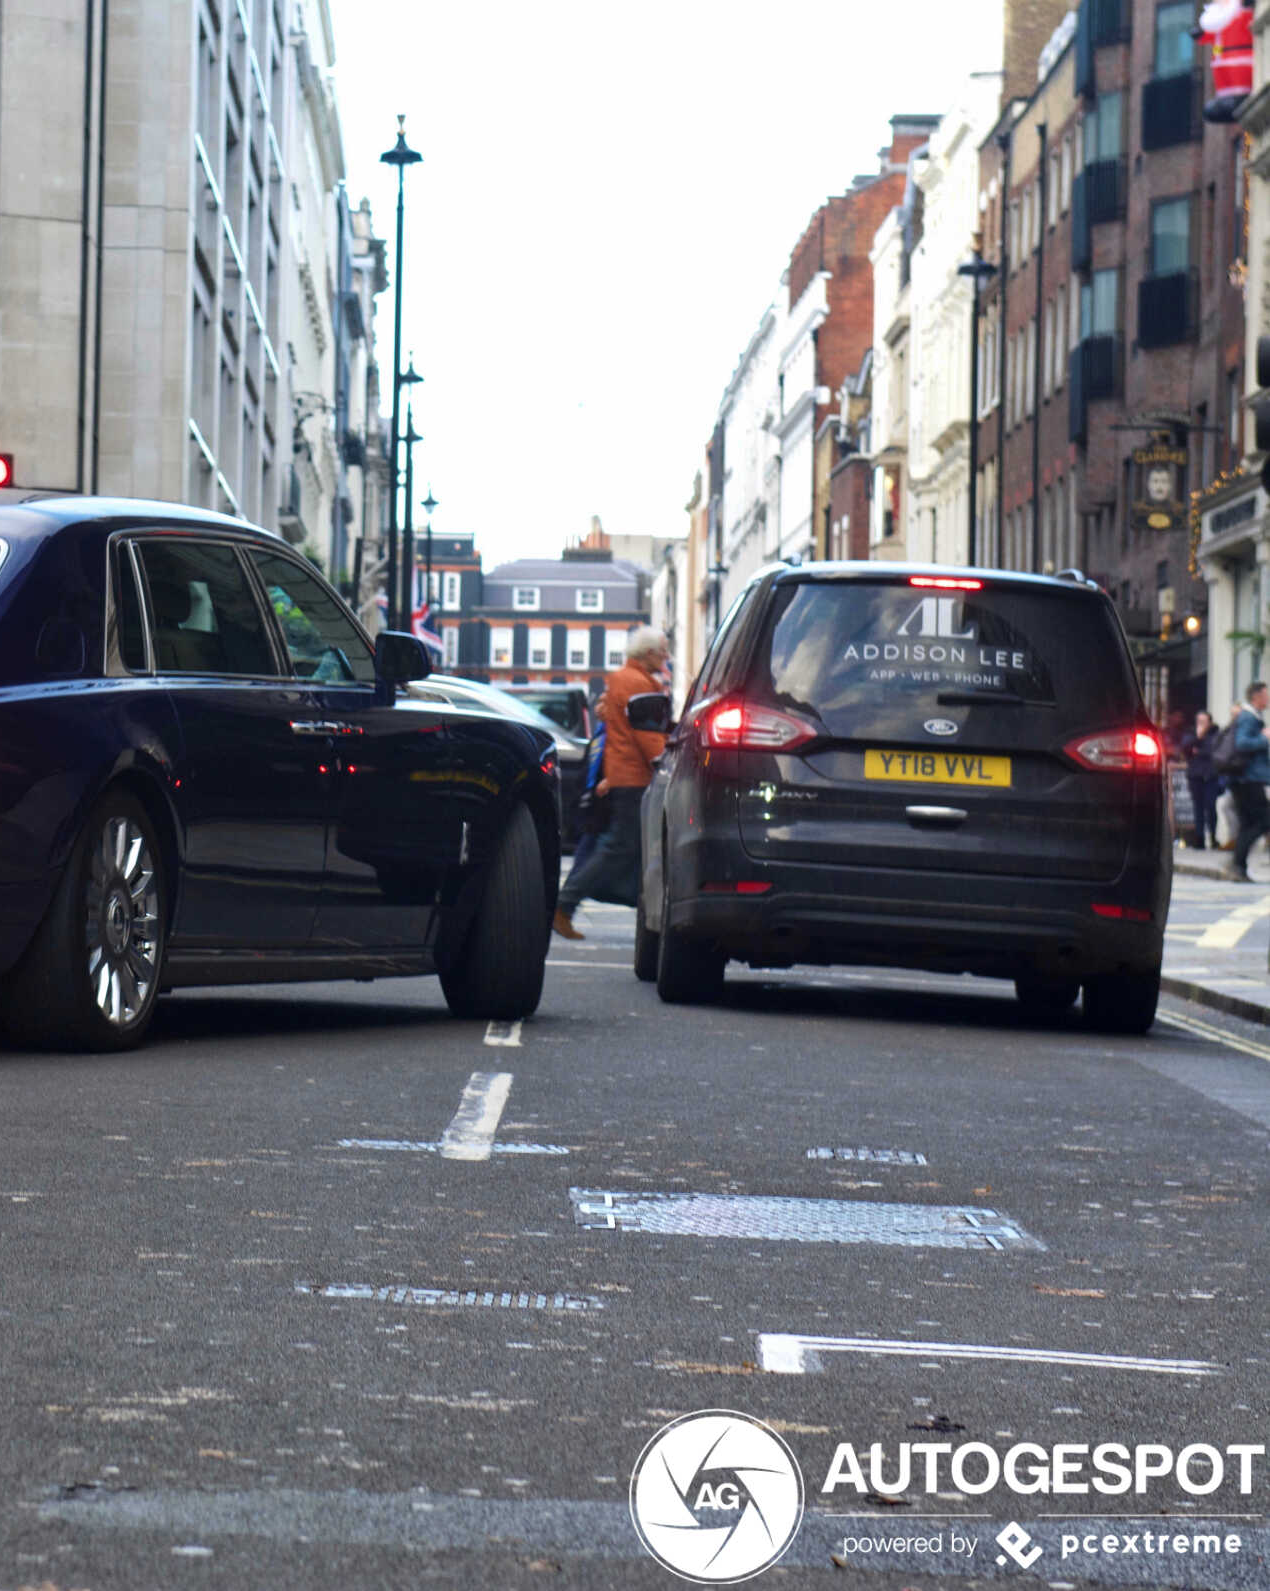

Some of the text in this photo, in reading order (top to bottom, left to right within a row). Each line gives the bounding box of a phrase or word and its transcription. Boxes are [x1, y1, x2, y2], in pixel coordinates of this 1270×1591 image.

[843, 643, 1025, 669] ADDISON LEE
[869, 670, 1001, 687] APP WEB PHONE
[879, 752, 993, 781] YT18 VVL
